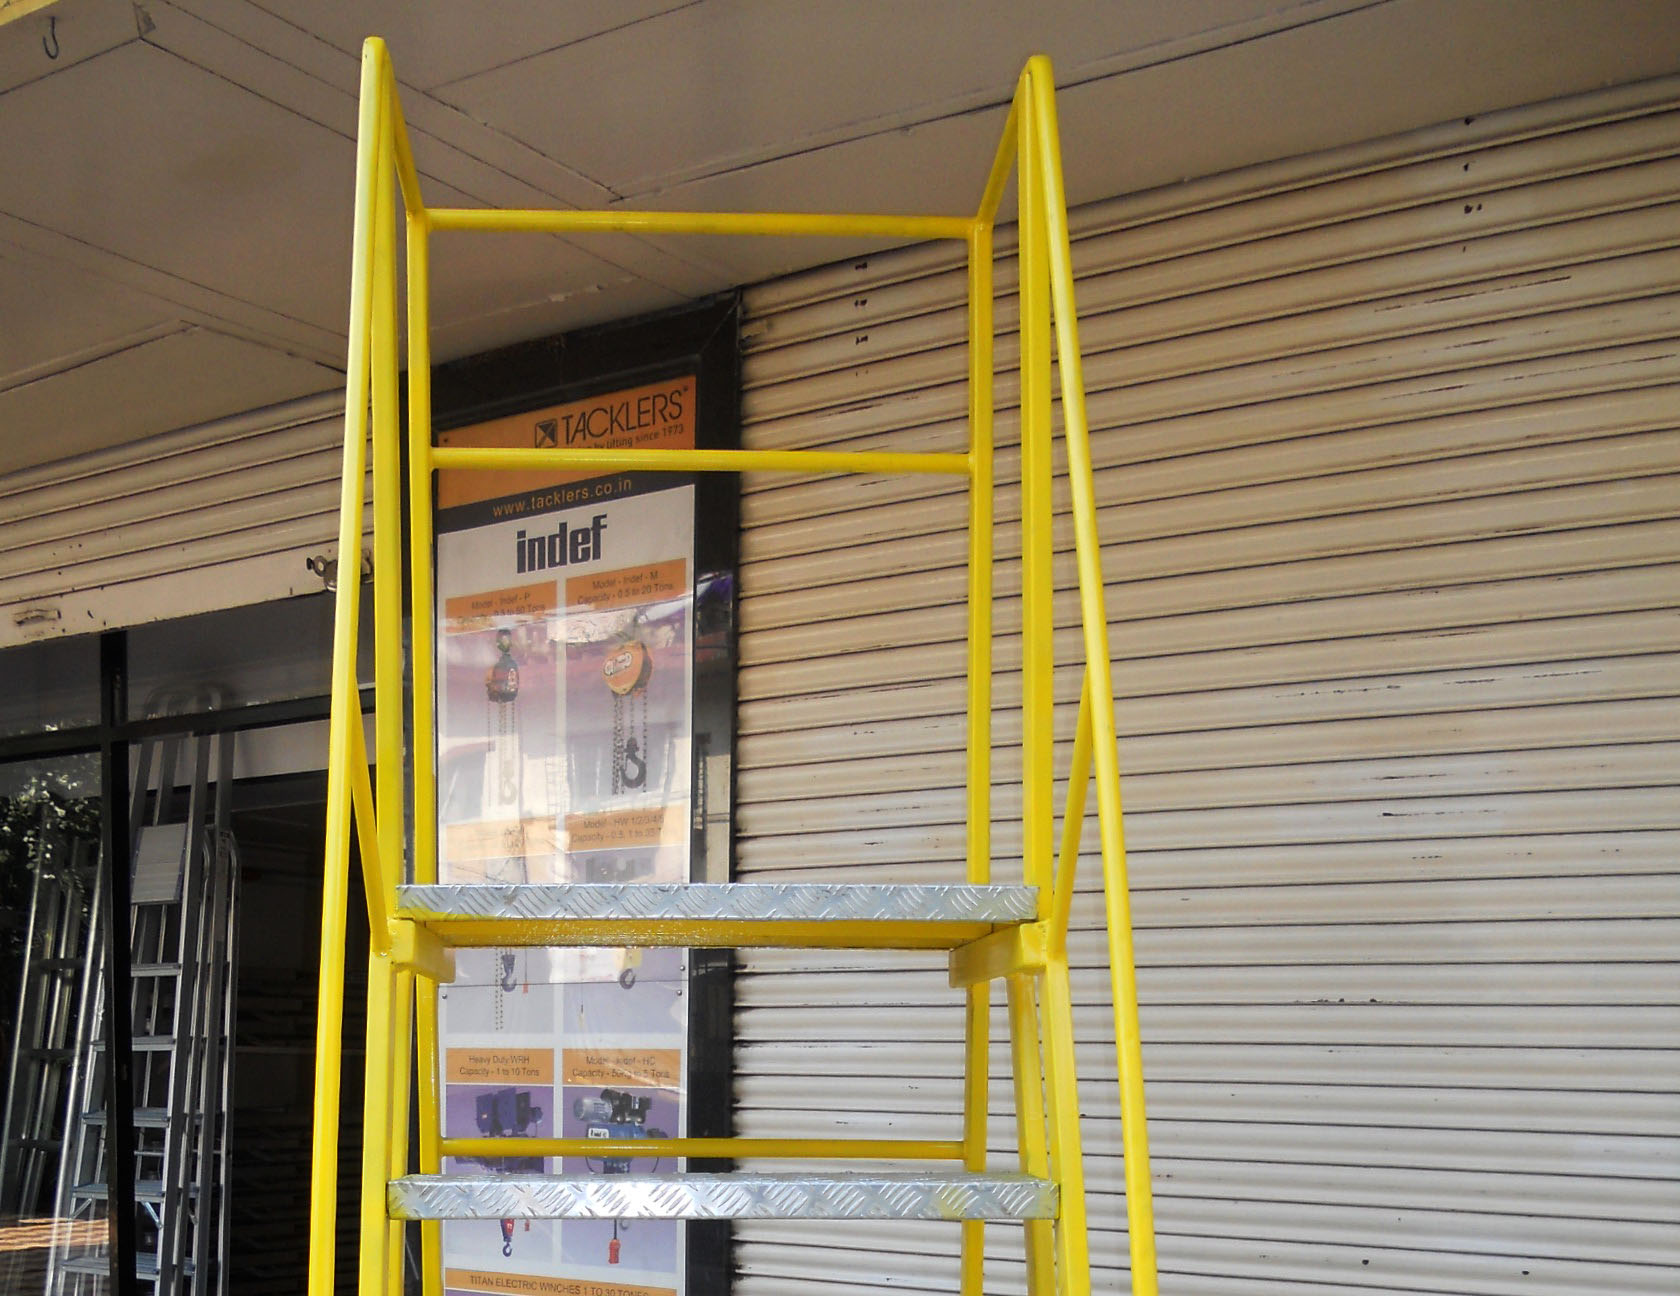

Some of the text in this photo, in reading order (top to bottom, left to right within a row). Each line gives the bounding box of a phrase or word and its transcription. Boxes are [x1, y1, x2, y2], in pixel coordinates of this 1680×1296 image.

[562, 389, 683, 445] TACKLERS
[635, 430, 660, 442] since
[663, 423, 685, 438] 1973
[492, 477, 633, 518] www.tacklers.co.in
[516, 513, 608, 574] indef
[468, 1055, 530, 1065] Heavy Duty WRH
[460, 1066, 490, 1077] Capacity
[502, 1068, 510, 1076] to
[511, 1068, 521, 1076] 10
[522, 1068, 540, 1077] Tons
[572, 1068, 604, 1078] Capacity
[651, 1069, 670, 1079] Tons
[470, 1275, 494, 1287] TITAN
[495, 1277, 537, 1291] ELECTRIC
[539, 1281, 581, 1295] WINCHES
[591, 1287, 604, 1296] TO
